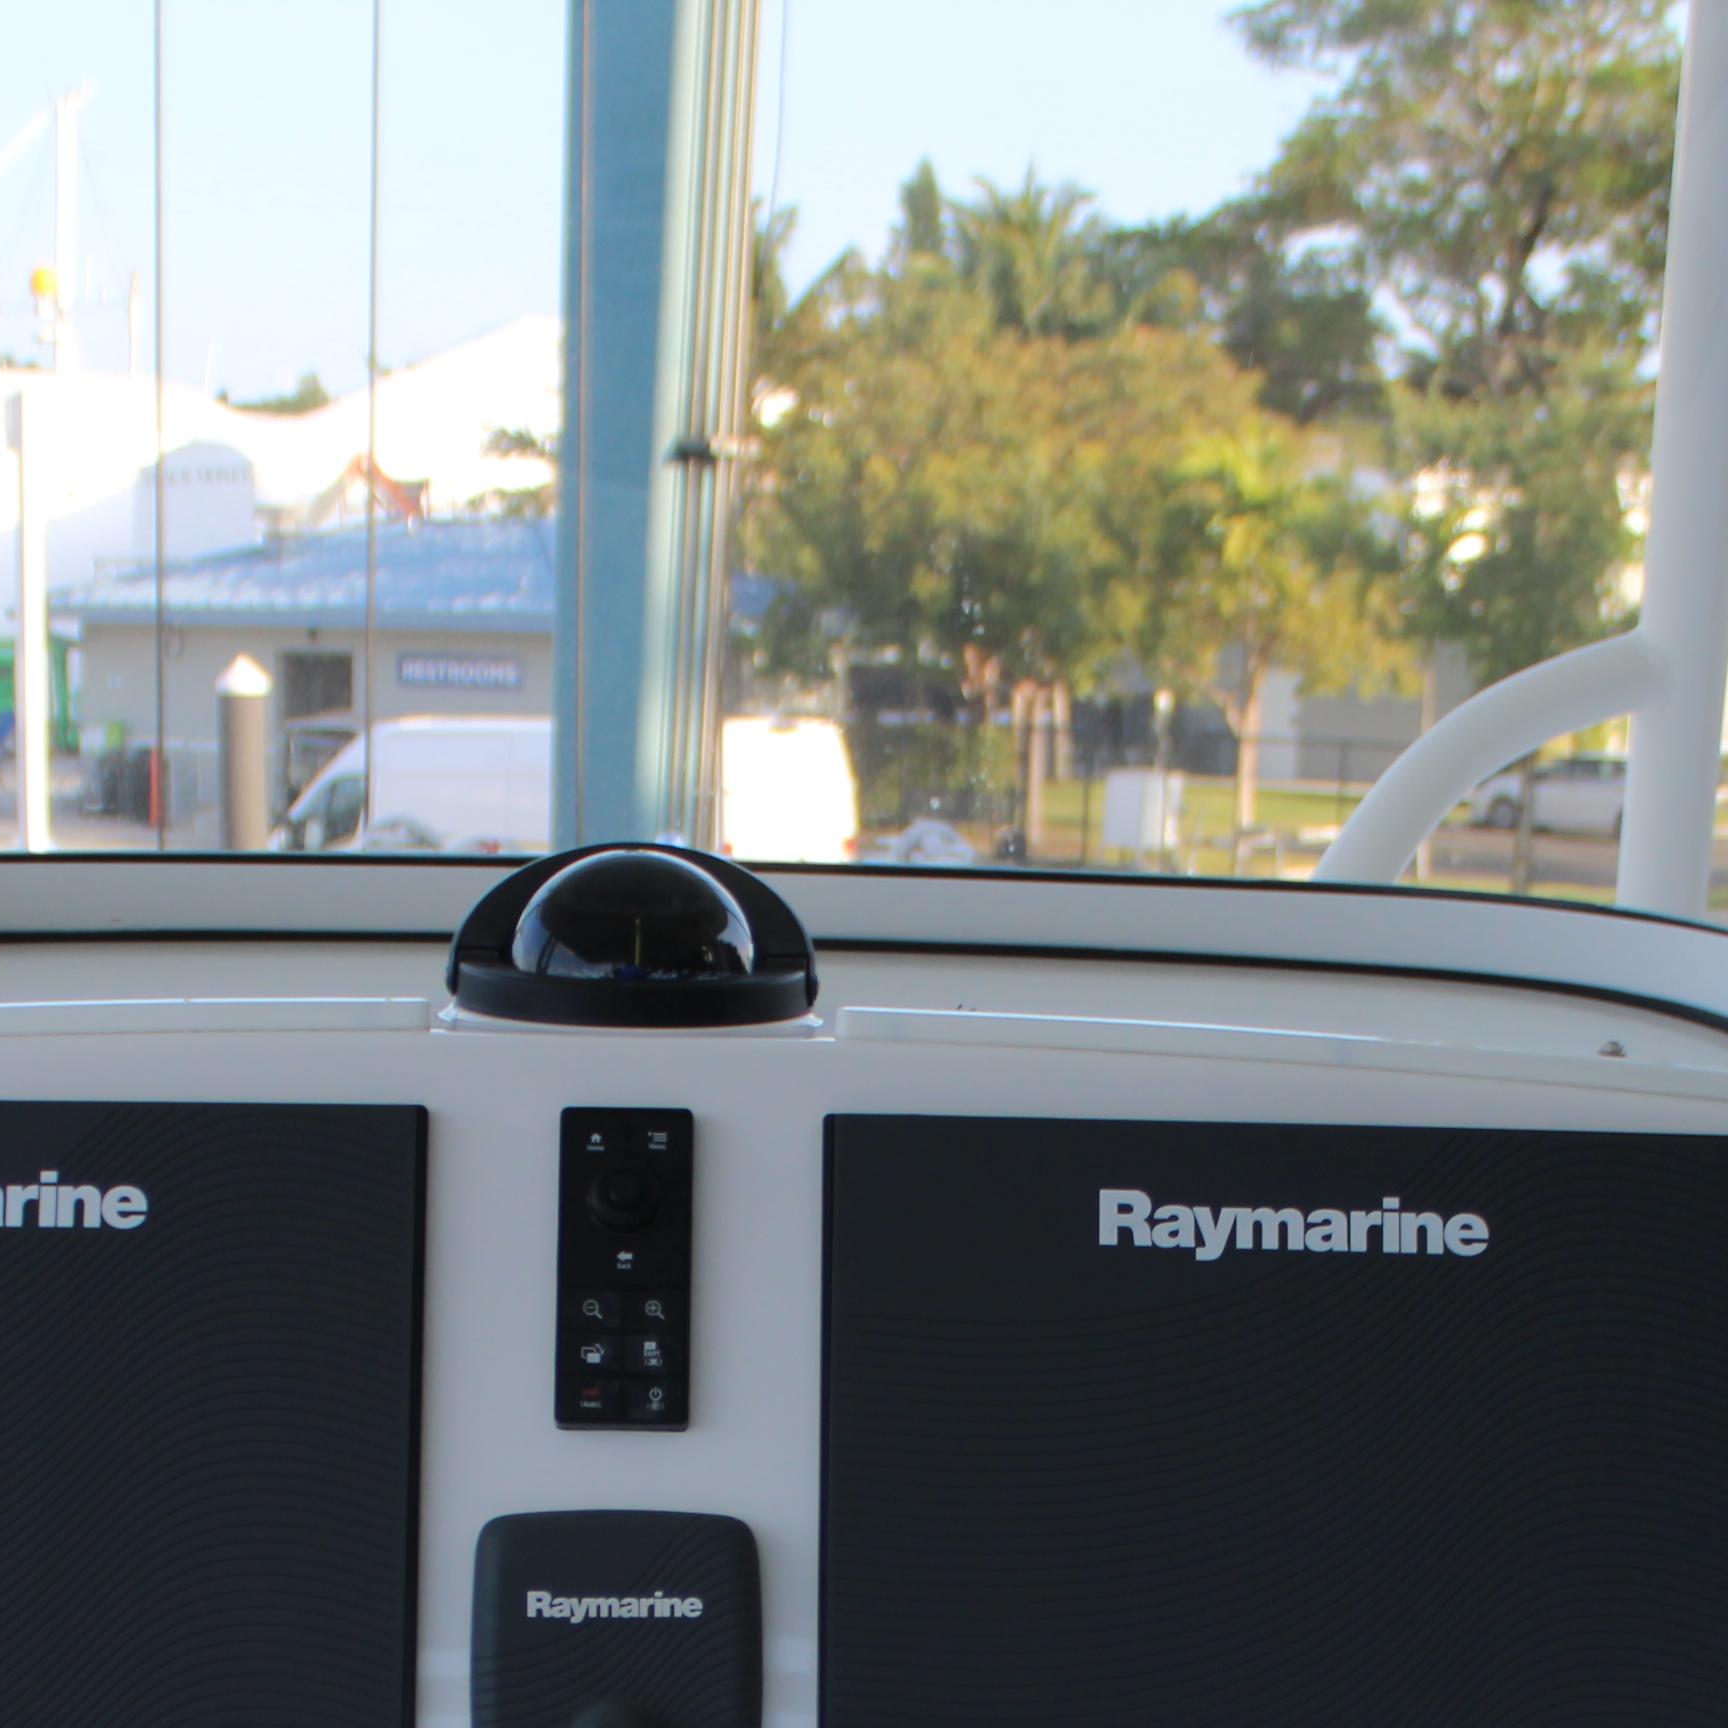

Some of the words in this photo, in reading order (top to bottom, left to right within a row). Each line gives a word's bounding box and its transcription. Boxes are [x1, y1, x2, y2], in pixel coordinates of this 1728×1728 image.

[401, 658, 518, 685] RESTROOMS
[1098, 1187, 1490, 1262] Raymarine
[526, 1587, 704, 1624] Raymarine
